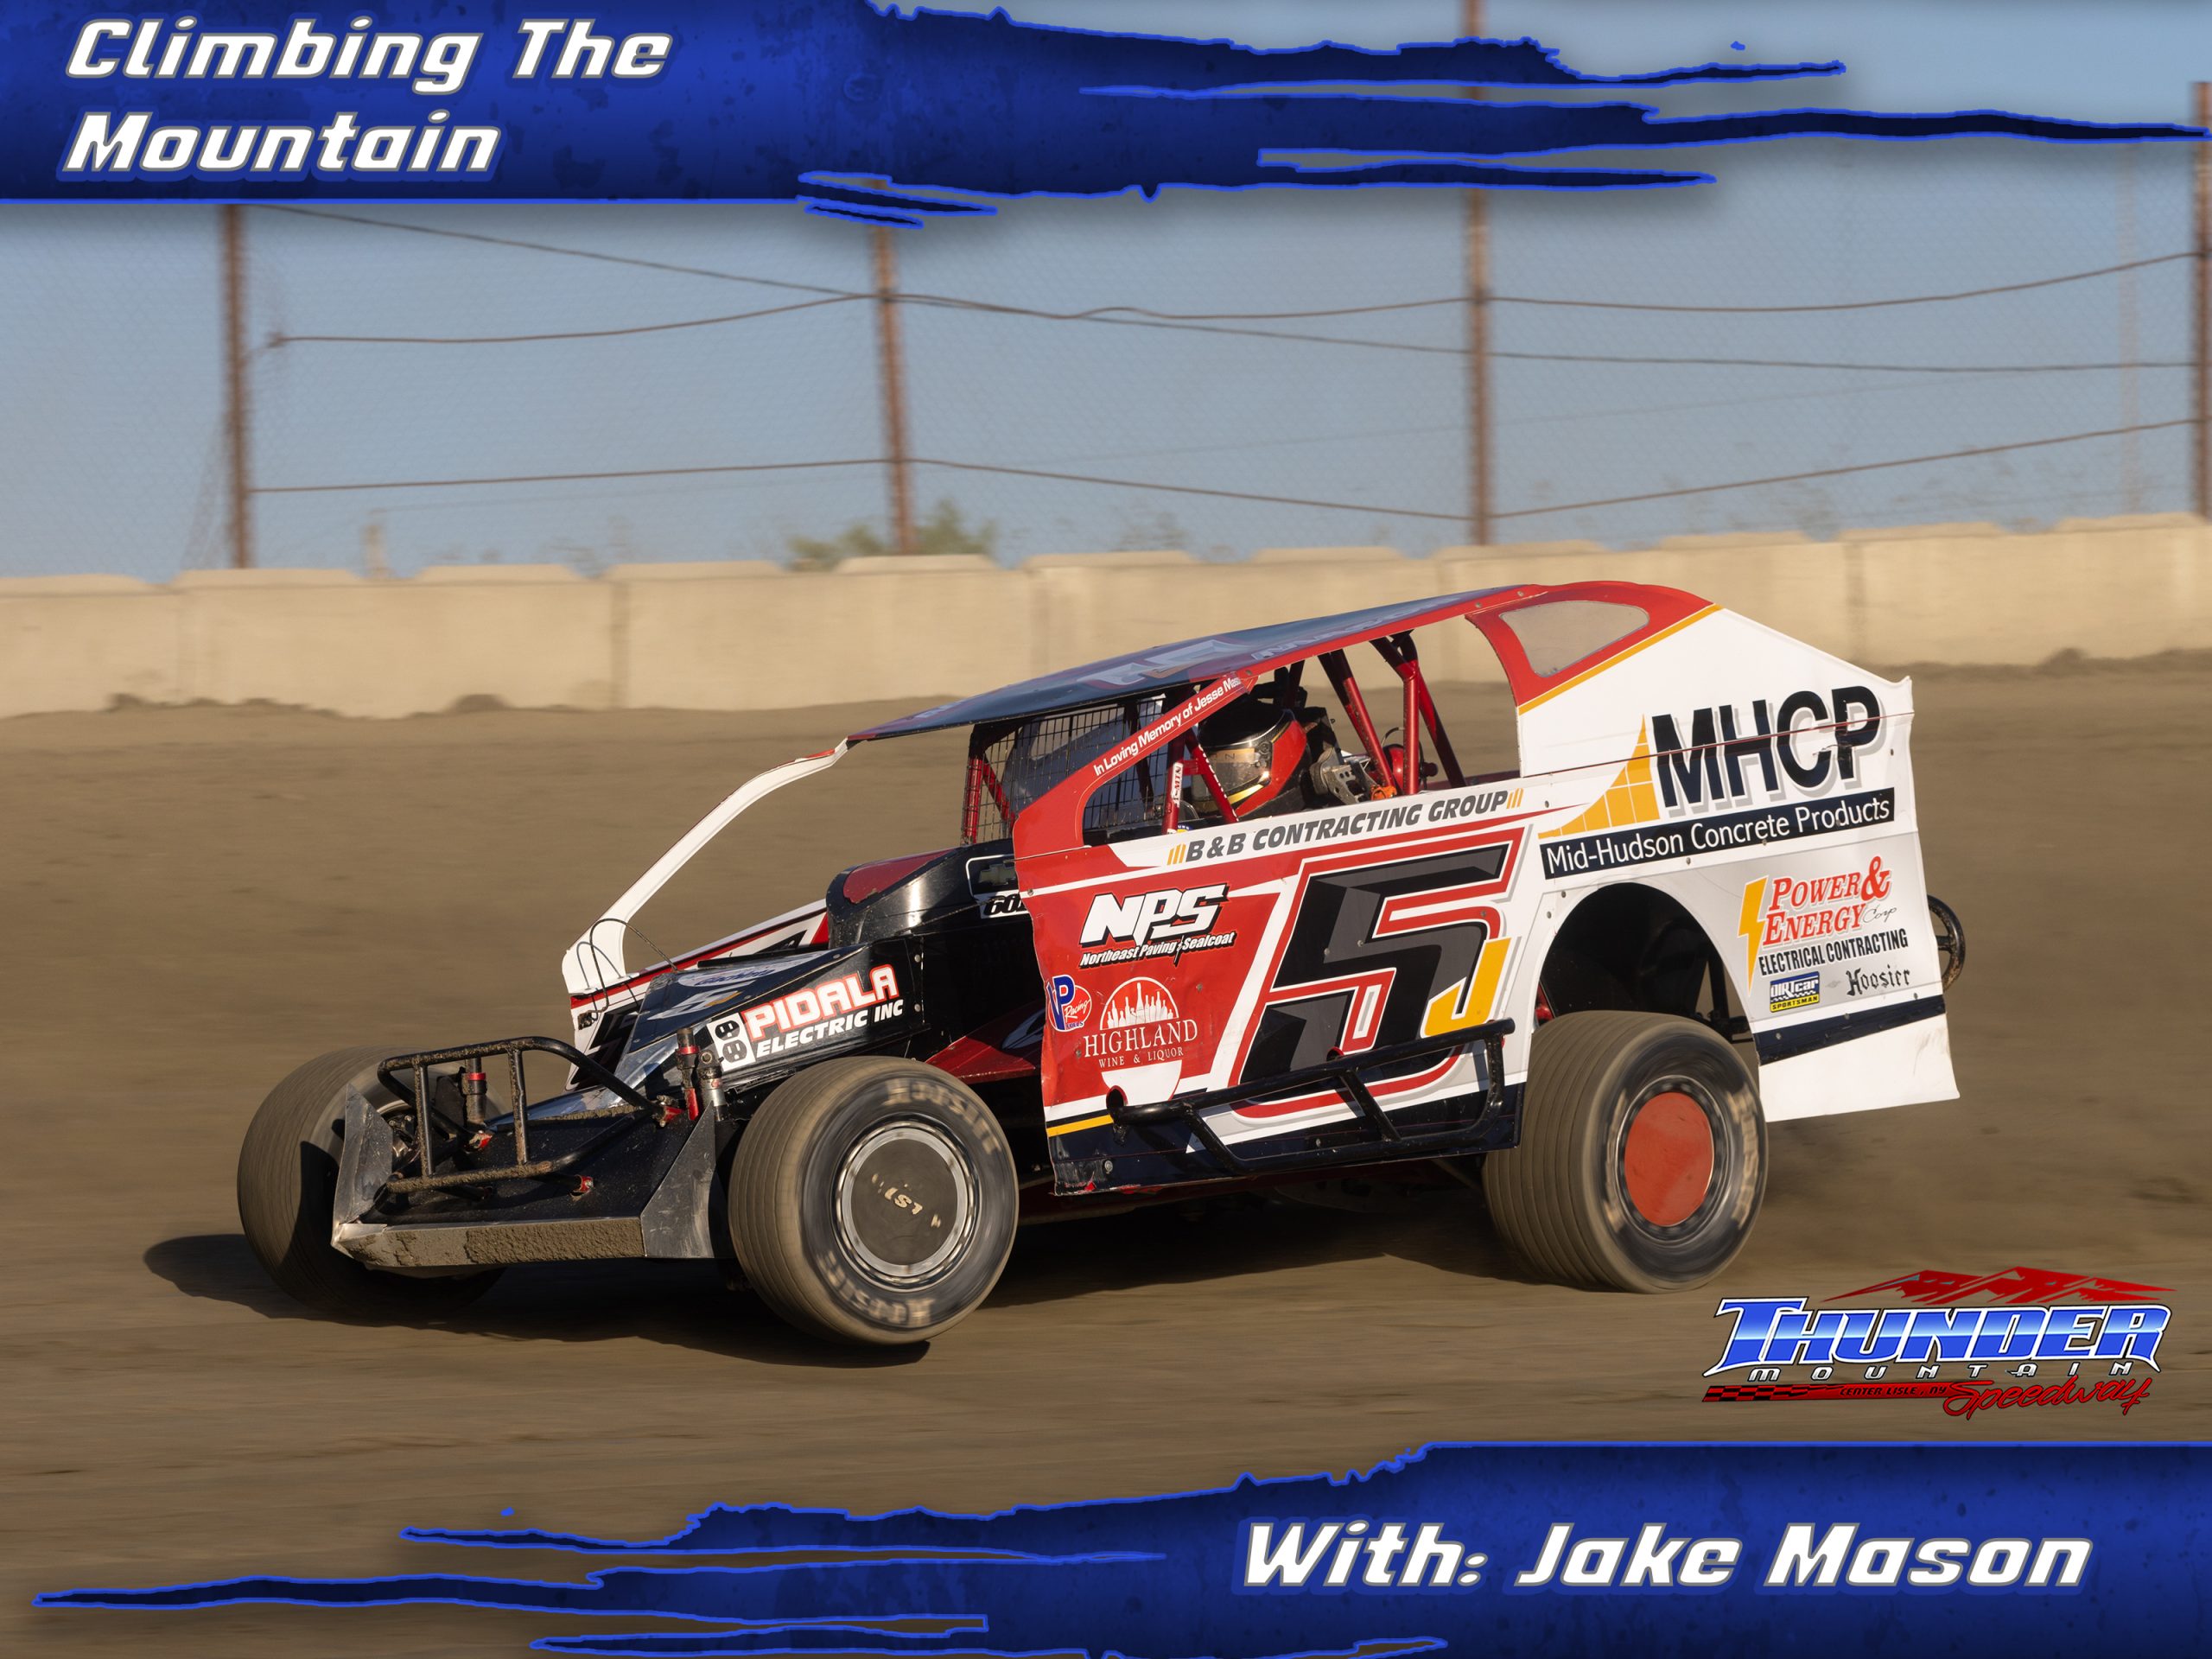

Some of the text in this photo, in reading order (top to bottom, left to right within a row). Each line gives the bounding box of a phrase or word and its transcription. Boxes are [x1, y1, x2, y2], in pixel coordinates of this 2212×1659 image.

[1093, 764, 1104, 777] In
[1103, 744, 1139, 771] Loving
[1137, 715, 1182, 749] Memory
[1182, 703, 1194, 719] of
[1195, 689, 1224, 712] Jesse
[1651, 685, 1882, 809] MHCP
[1185, 790, 1508, 862] B & B CONTRACTING GROUP
[1545, 795, 1891, 874] Mid-Hudson Concrete Products
[1079, 884, 1229, 947] NPS
[1079, 947, 1138, 969] Northeast
[1138, 940, 1177, 959] Paving
[1182, 931, 1236, 953] Sealcoat
[1759, 927, 1909, 976] ELECTRICAL CONTRACTING
[742, 964, 899, 1042] PIDALA
[1046, 975, 1075, 1032] VP
[1771, 995, 1819, 1010] SPORTSMAN
[1846, 964, 1910, 997] Hoosier
[755, 999, 904, 1058] ELECTRIC INC
[1064, 999, 1090, 1023] Racing
[1083, 1019, 1198, 1058] HIGHLAND
[1098, 1046, 1185, 1069] WINE & LIQUOR
